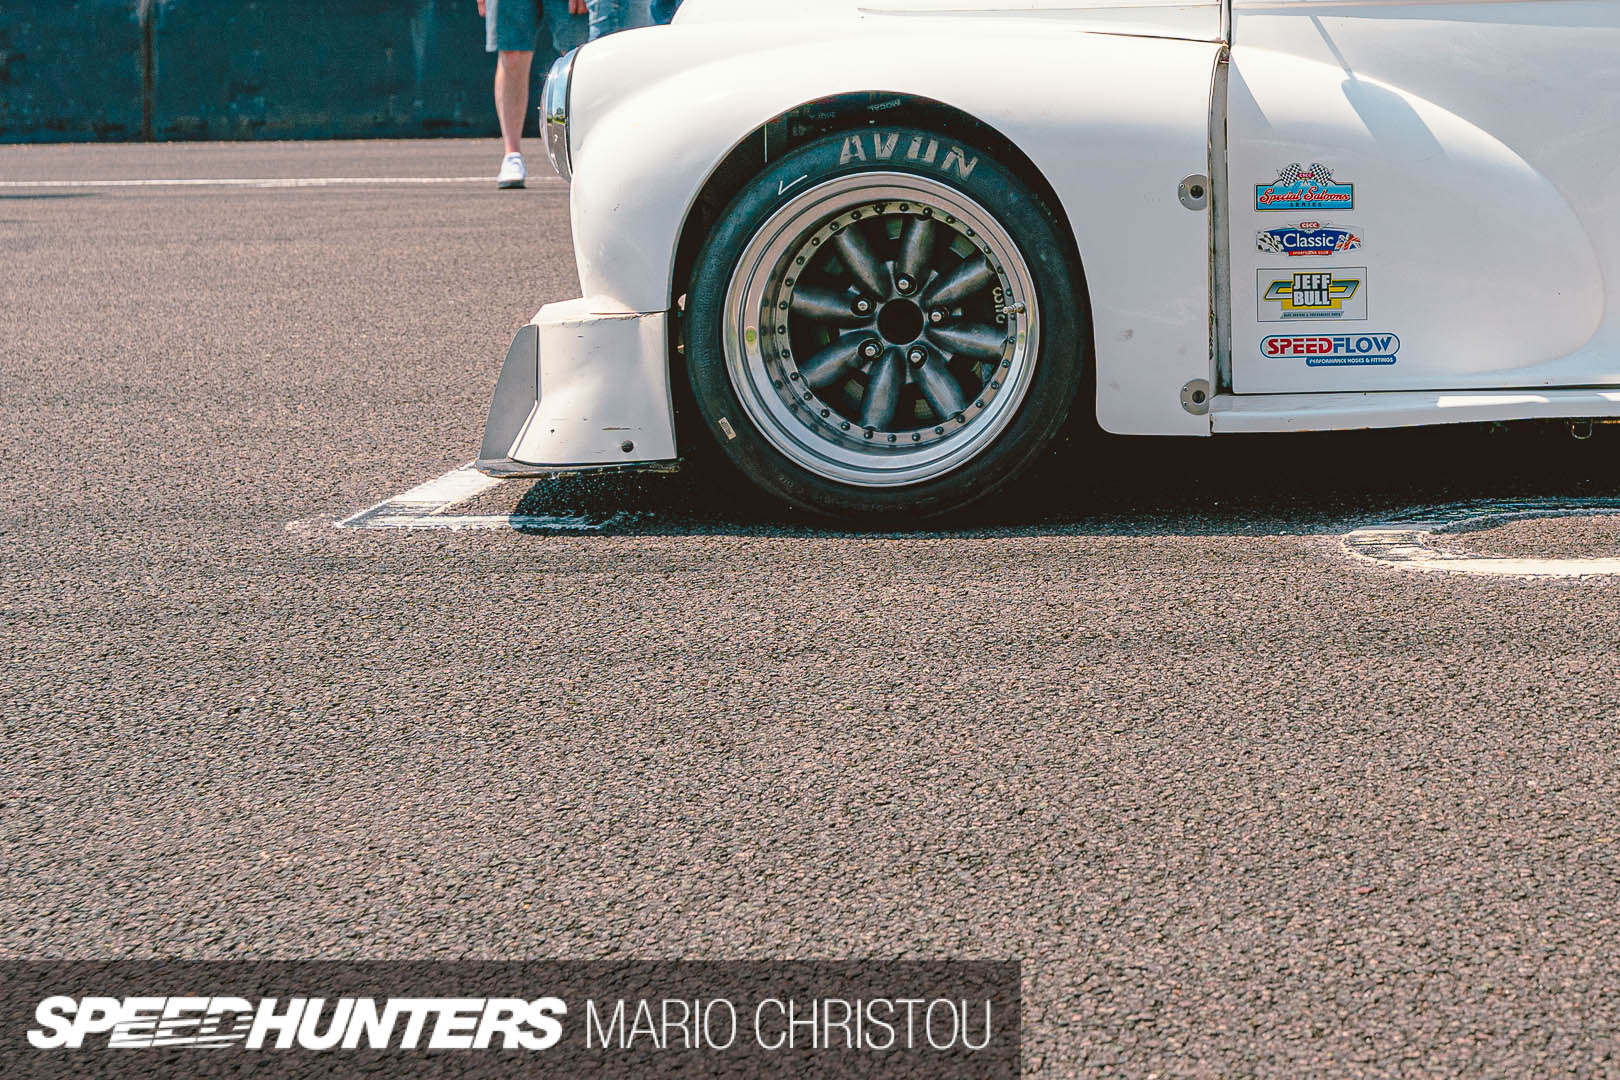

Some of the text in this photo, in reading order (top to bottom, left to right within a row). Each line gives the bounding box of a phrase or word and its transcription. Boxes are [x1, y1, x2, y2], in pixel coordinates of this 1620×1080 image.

[1259, 186, 1350, 205] Special Saloons
[1283, 233, 1334, 248] Classic
[1293, 274, 1330, 289] JEFF
[1293, 290, 1330, 306] BULL
[1267, 336, 1392, 355] SPEEDFLOW
